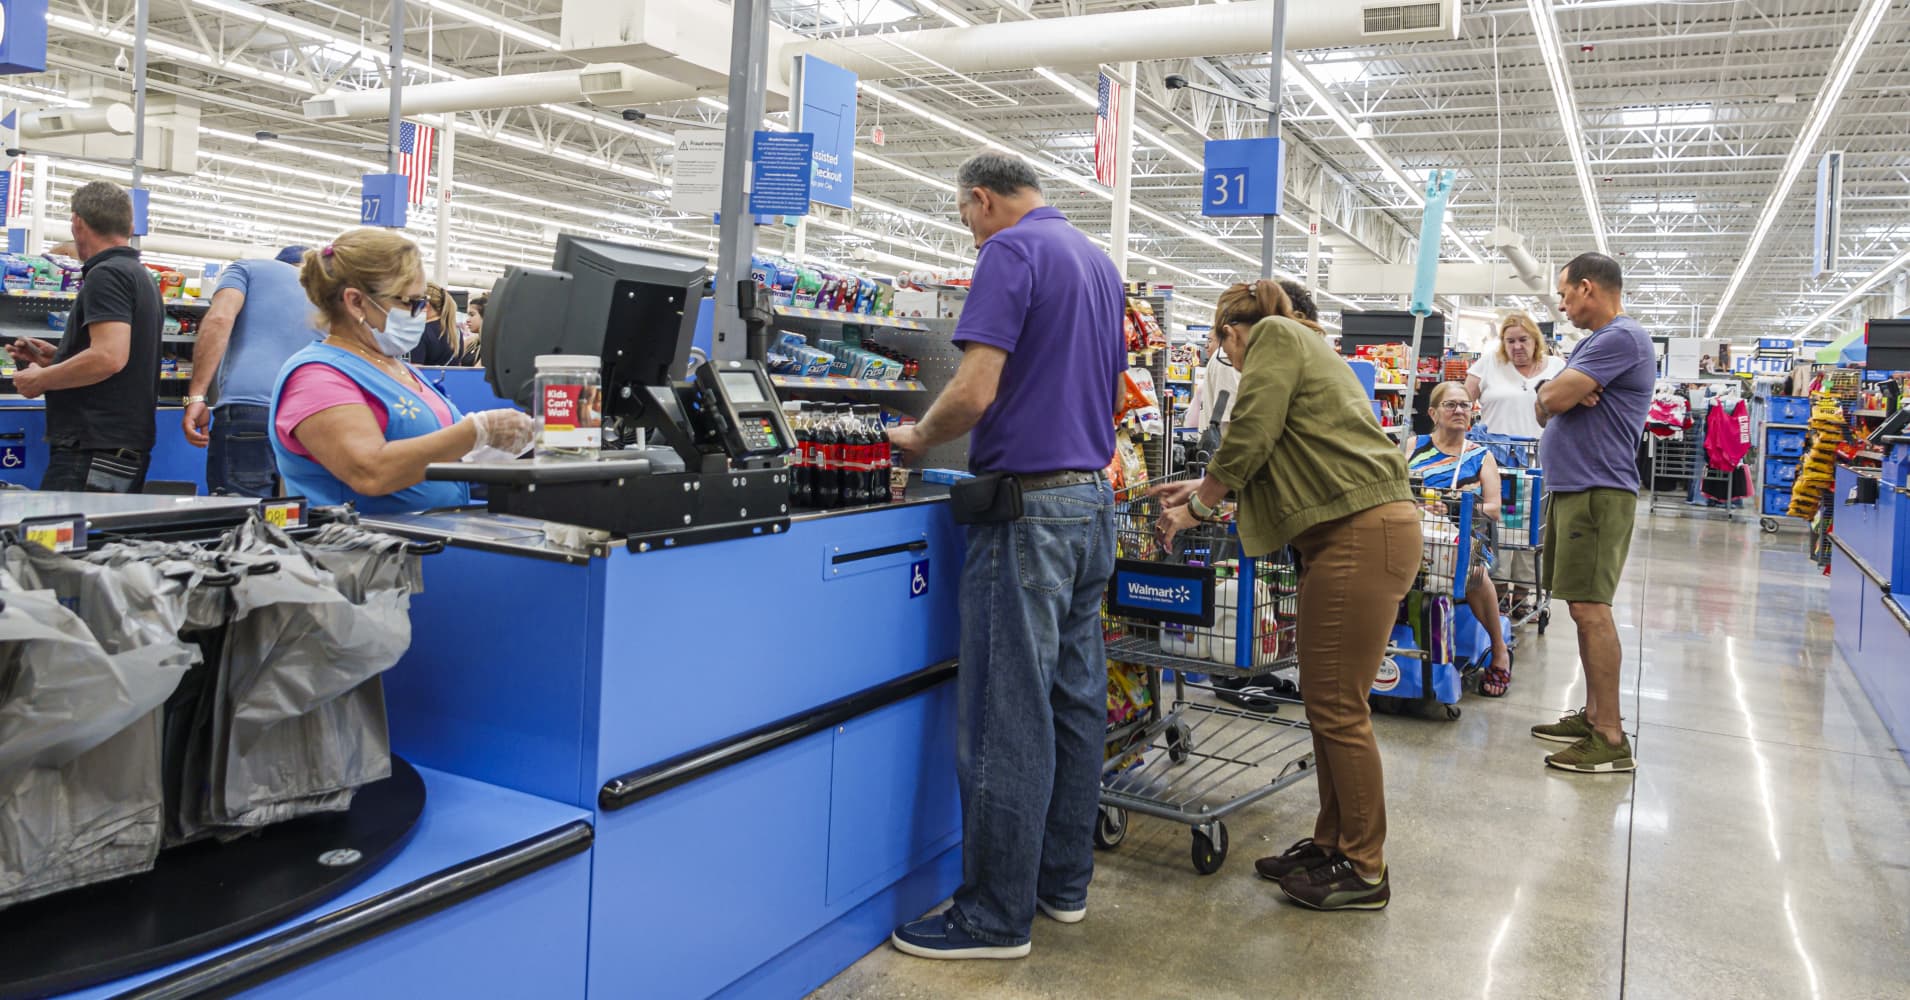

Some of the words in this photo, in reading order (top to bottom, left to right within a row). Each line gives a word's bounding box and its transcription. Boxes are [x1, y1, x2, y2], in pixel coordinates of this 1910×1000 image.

[812, 150, 838, 166] ssisted
[1211, 173, 1245, 206] 31
[363, 198, 380, 222] 27
[547, 389, 567, 399] Kids
[547, 399, 573, 408] Can't
[547, 408, 570, 417] Wait
[1128, 582, 1174, 599] Walmart
